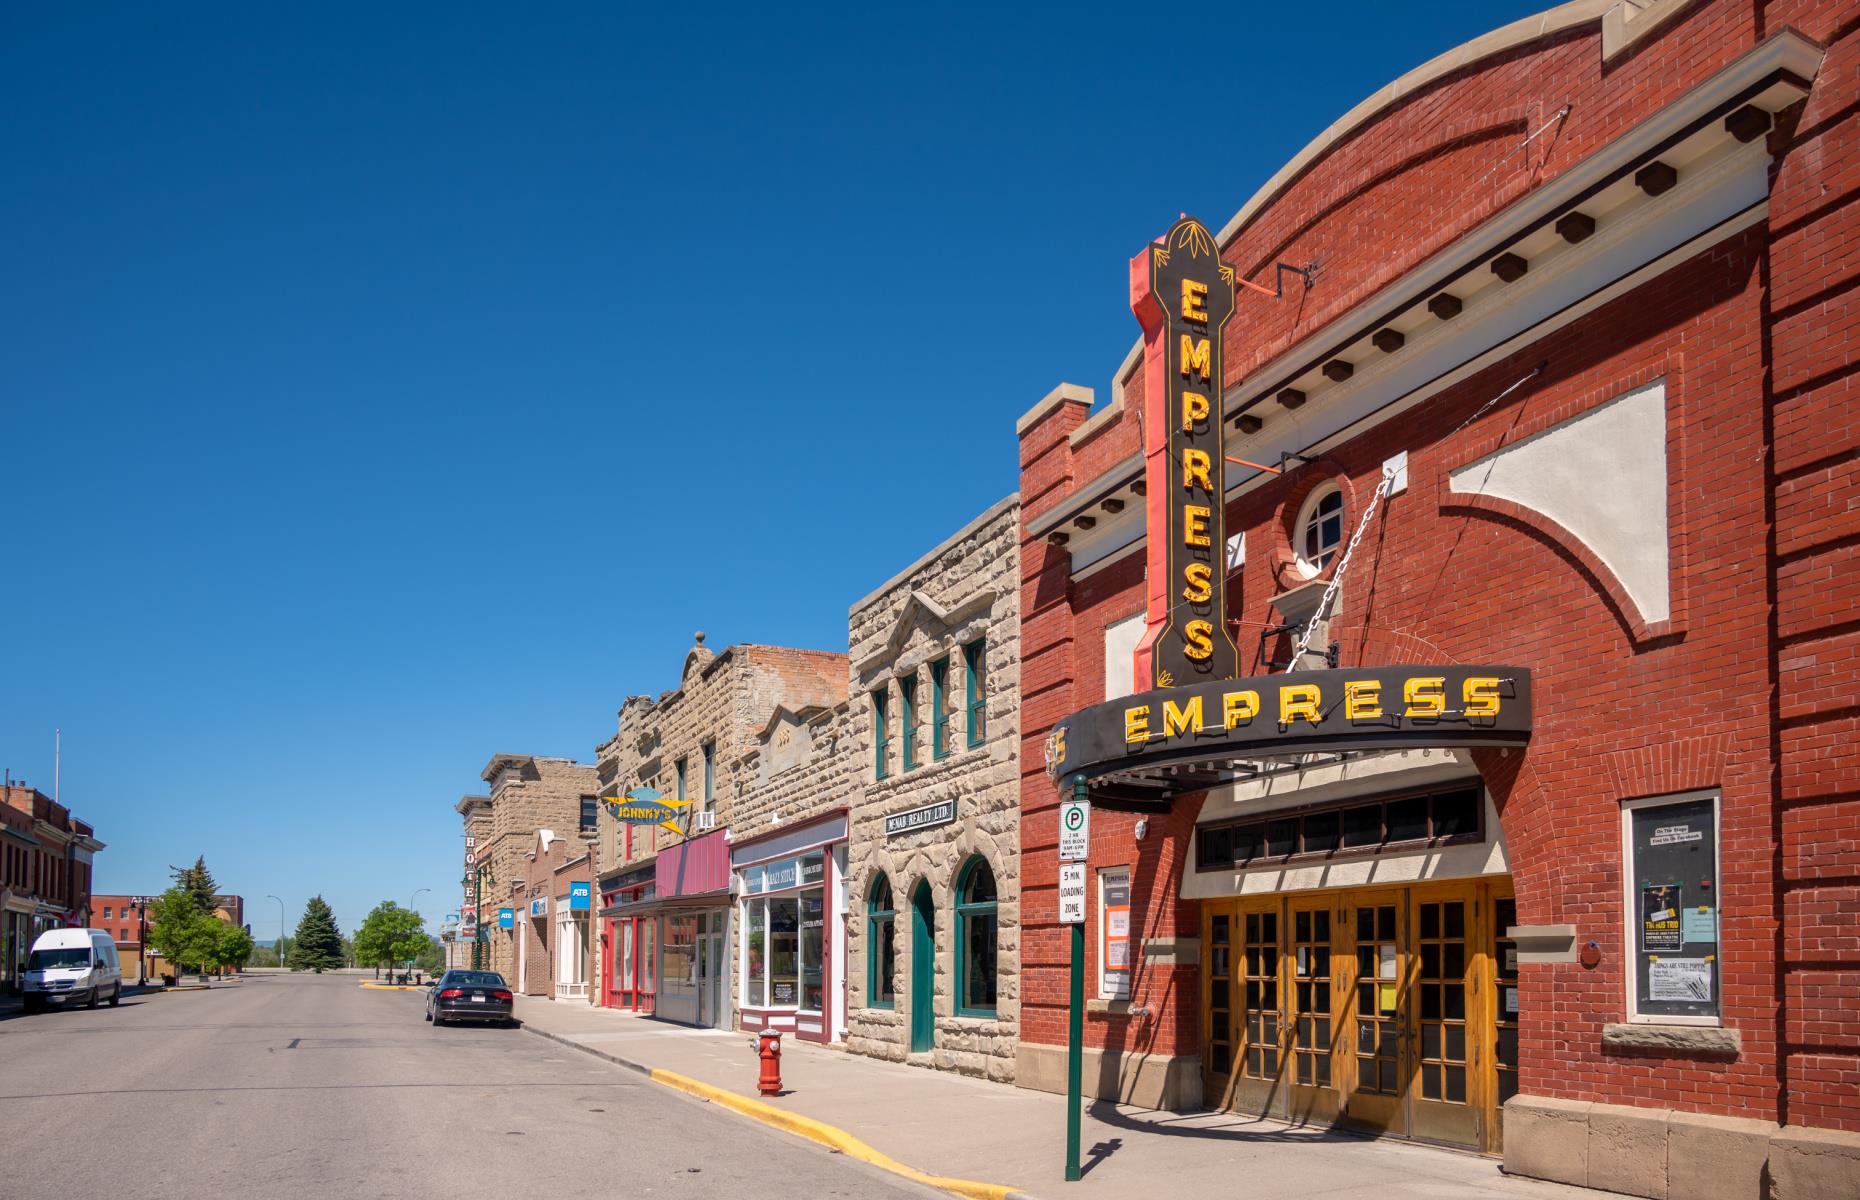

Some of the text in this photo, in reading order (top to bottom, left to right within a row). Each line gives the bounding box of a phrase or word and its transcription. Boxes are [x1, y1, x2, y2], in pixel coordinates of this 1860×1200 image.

[1181, 278, 1214, 661] EMPRESS
[1124, 676, 1502, 744] EMPRESS
[617, 807, 671, 819] JOHNNY'S
[908, 810, 932, 826] REALTY
[1070, 812, 1079, 826] P
[466, 837, 475, 907] HOTE
[1064, 871, 1069, 881] 5
[572, 888, 588, 896] ATB
[1061, 886, 1084, 898] LOADING
[1065, 903, 1079, 913] ZONE
